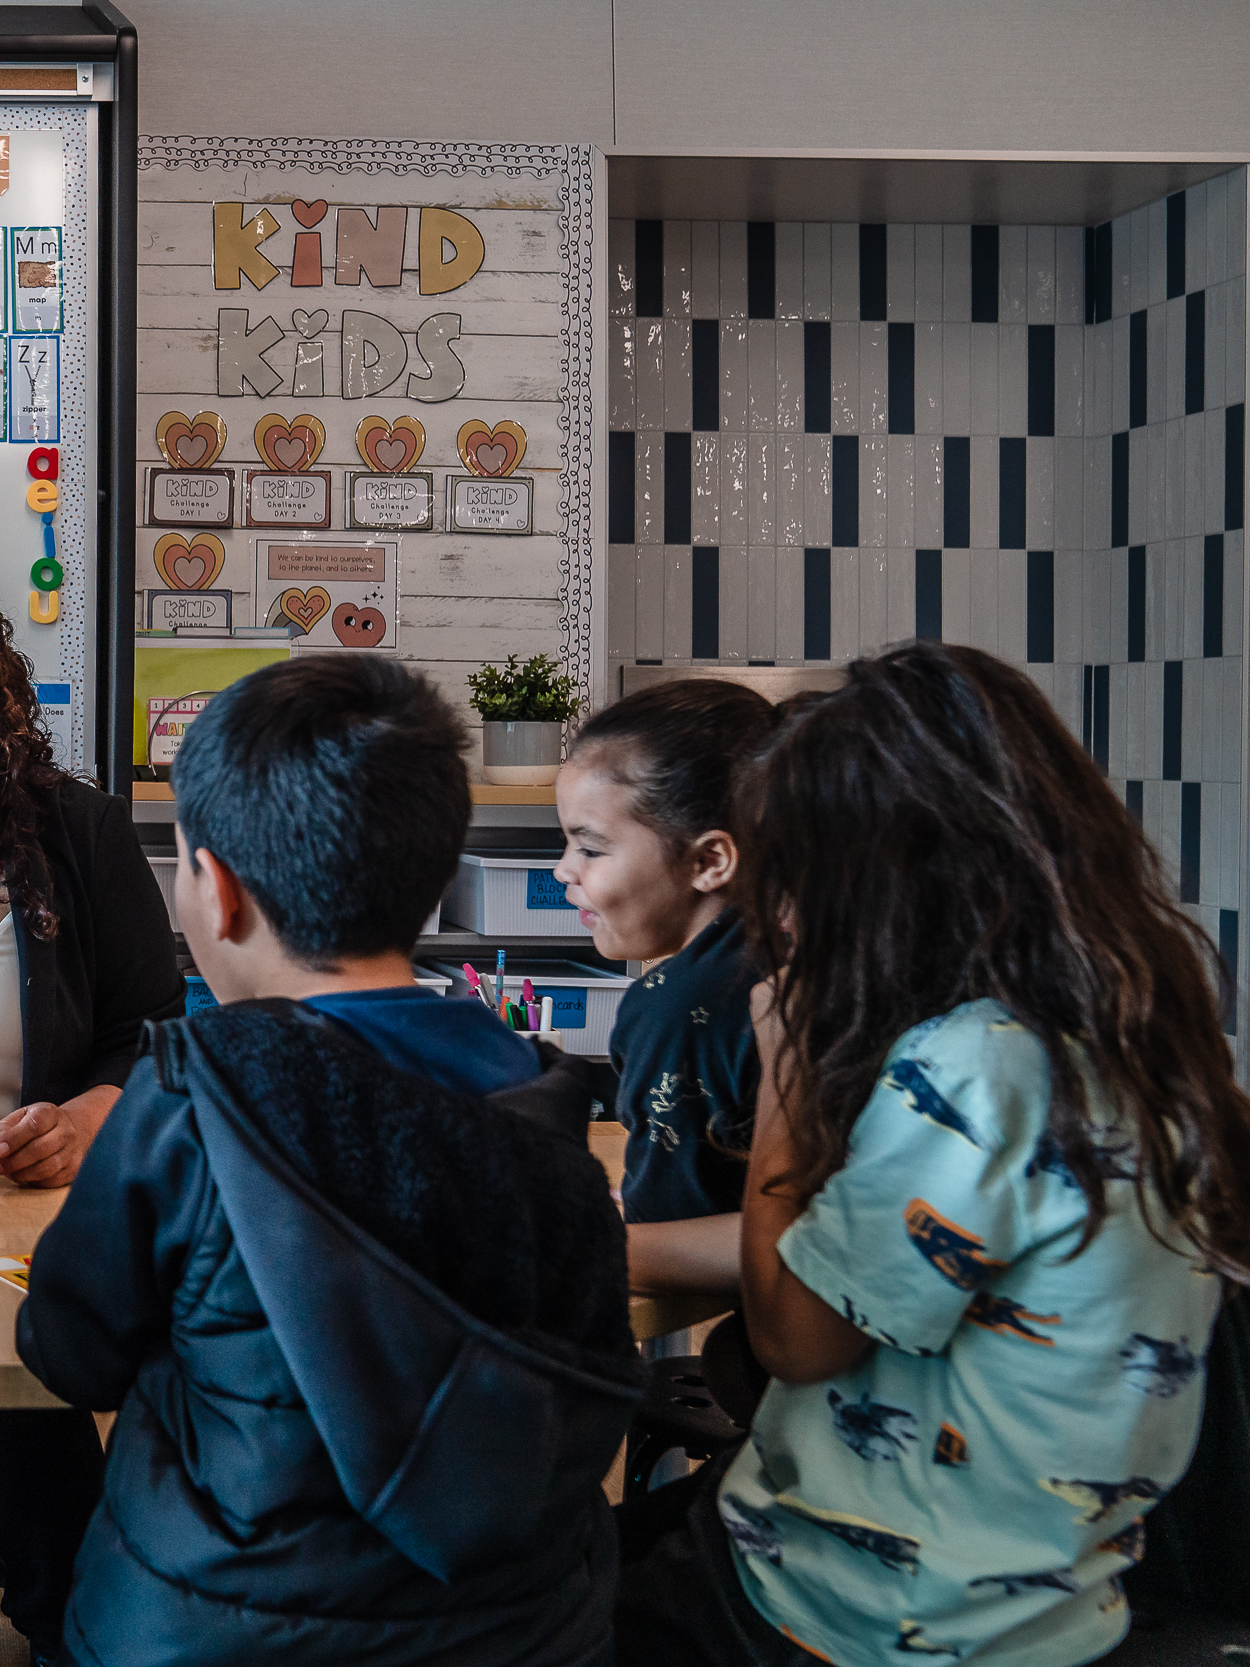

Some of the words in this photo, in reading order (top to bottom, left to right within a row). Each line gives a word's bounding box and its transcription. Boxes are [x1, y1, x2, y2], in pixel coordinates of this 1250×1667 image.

[28, 447, 58, 480] a
[27, 479, 58, 513] e
[268, 501, 306, 509] Challenge
[42, 512, 56, 558] i
[31, 557, 63, 591] o
[302, 564, 324, 573] planet,
[30, 591, 59, 624] u
[46, 707, 64, 715] Does
